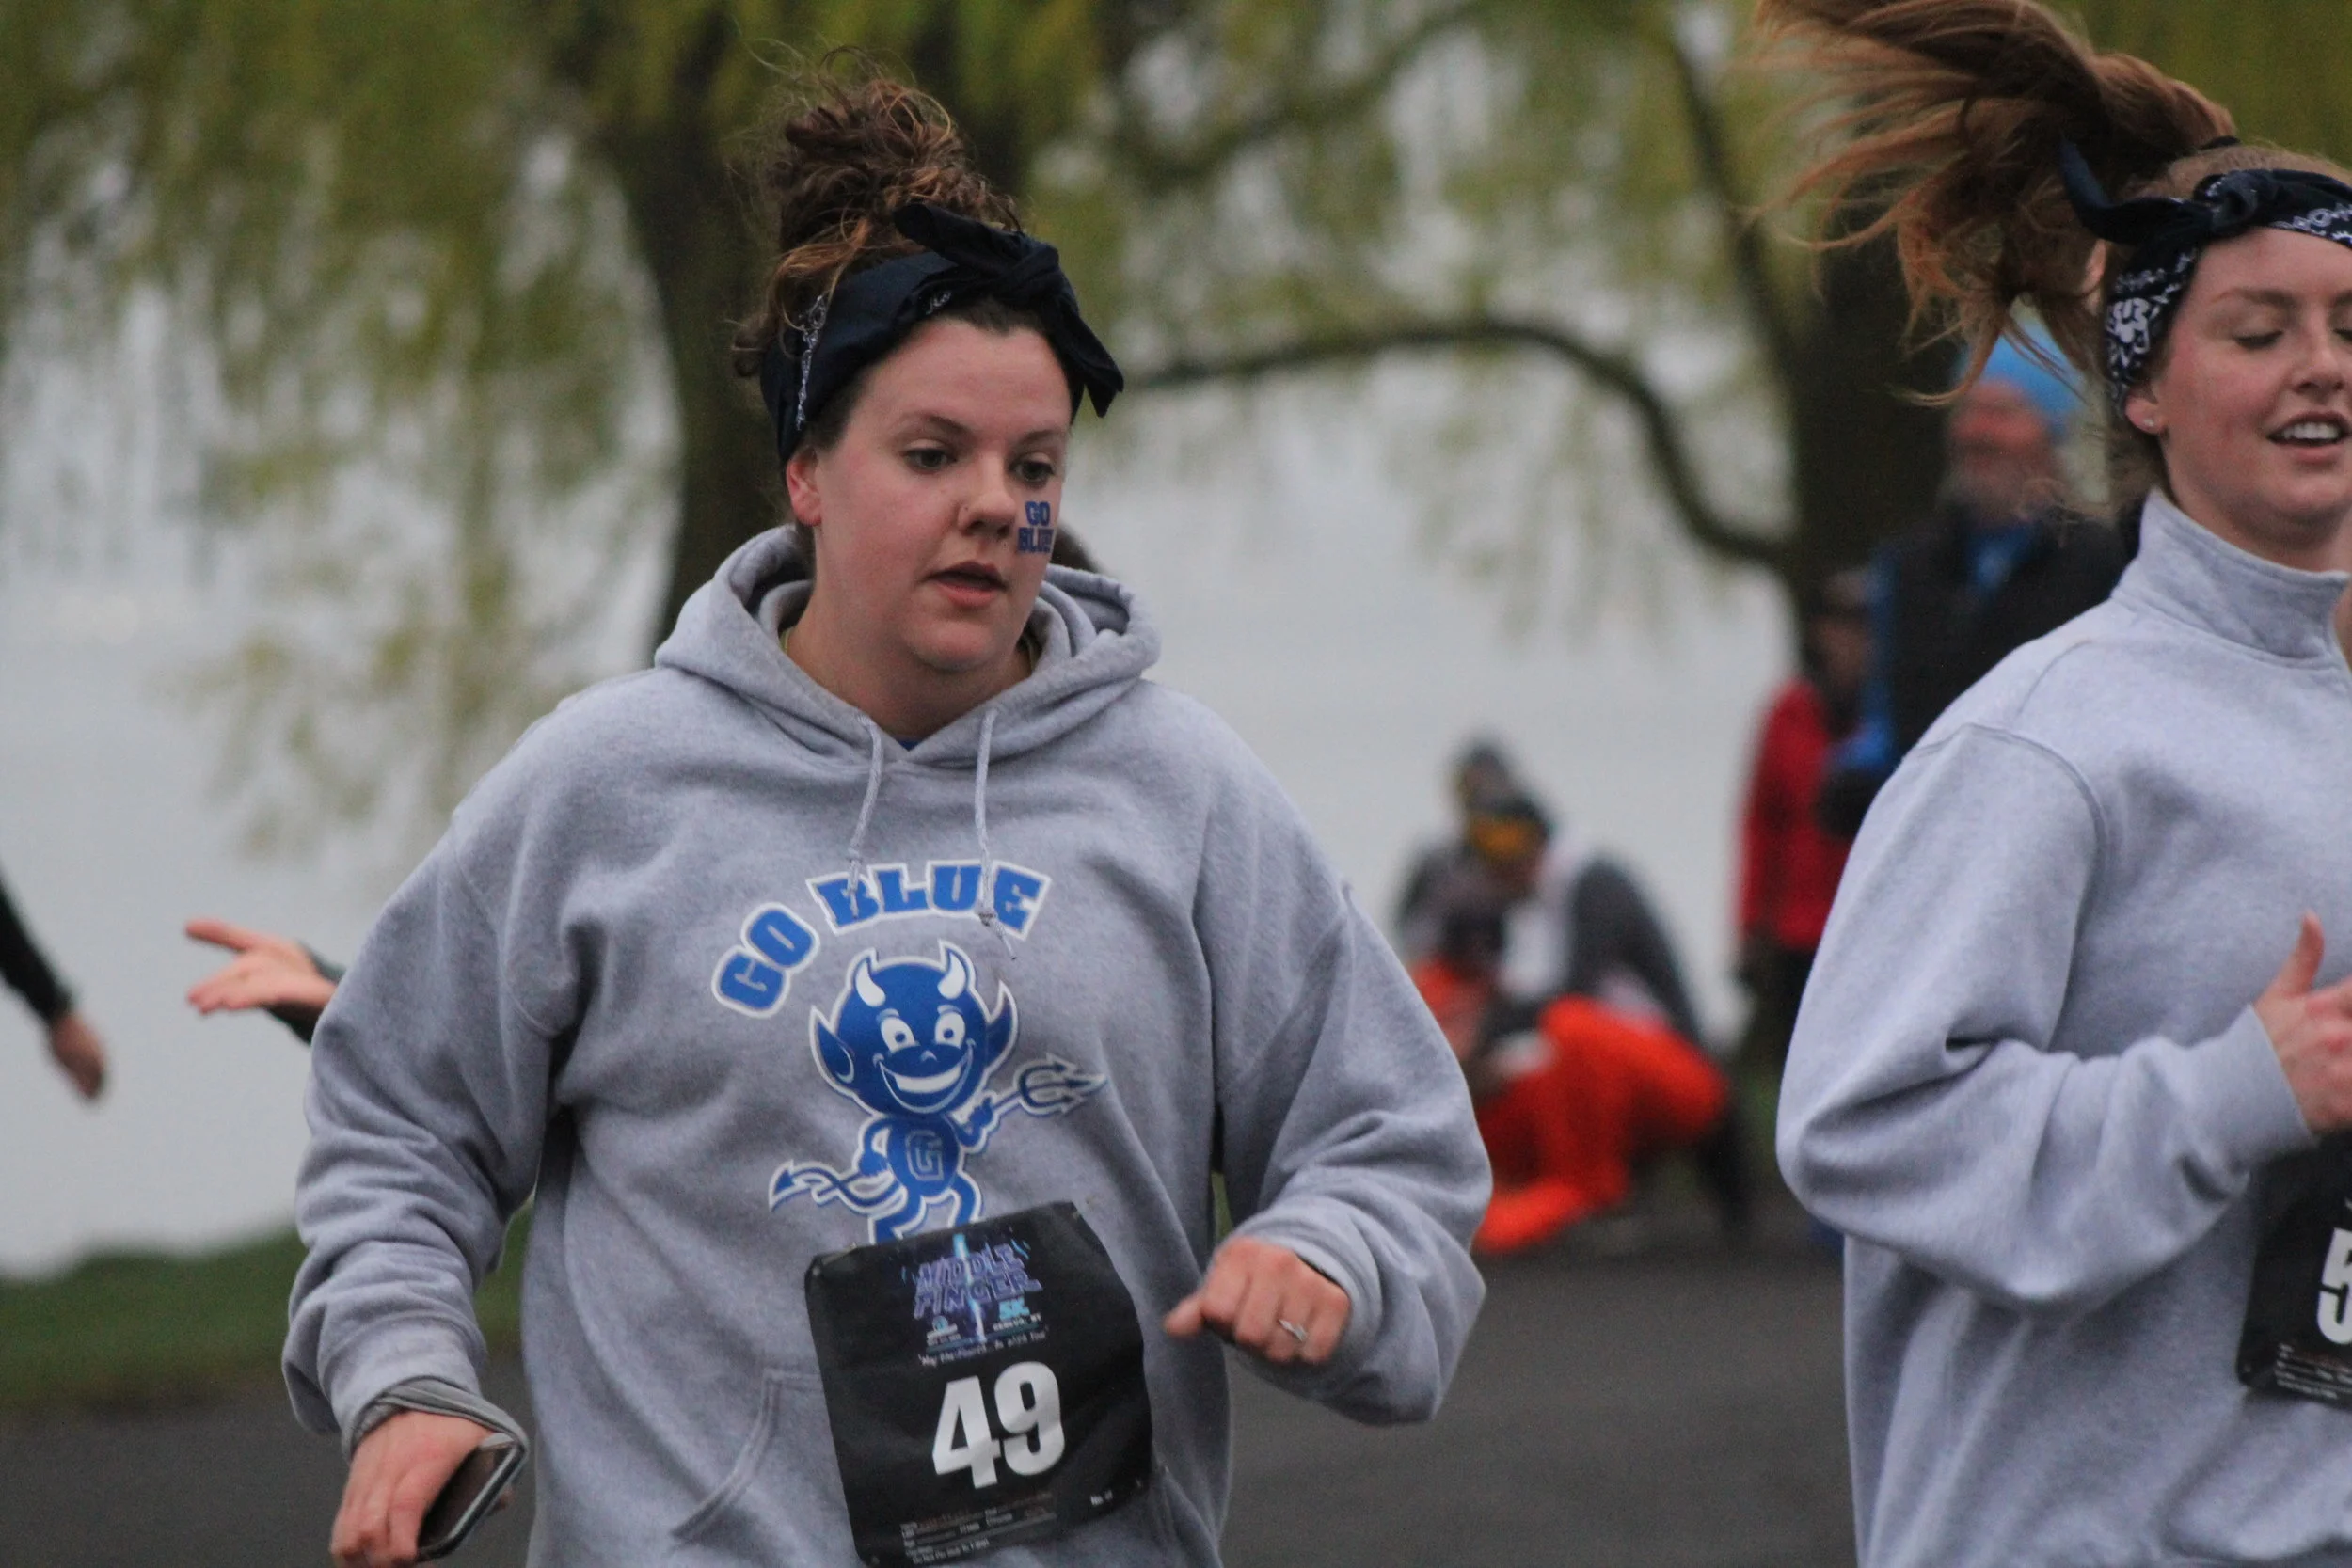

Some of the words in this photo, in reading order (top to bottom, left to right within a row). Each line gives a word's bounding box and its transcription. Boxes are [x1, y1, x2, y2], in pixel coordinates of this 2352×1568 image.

[1025, 501, 1051, 526] GO
[1018, 528, 1054, 553] BLUE
[711, 903, 820, 1018] GO
[805, 860, 1052, 940] BLUE
[905, 1130, 944, 1181] G
[914, 1271, 1043, 1320] FINGER
[931, 1361, 1065, 1489] 49
